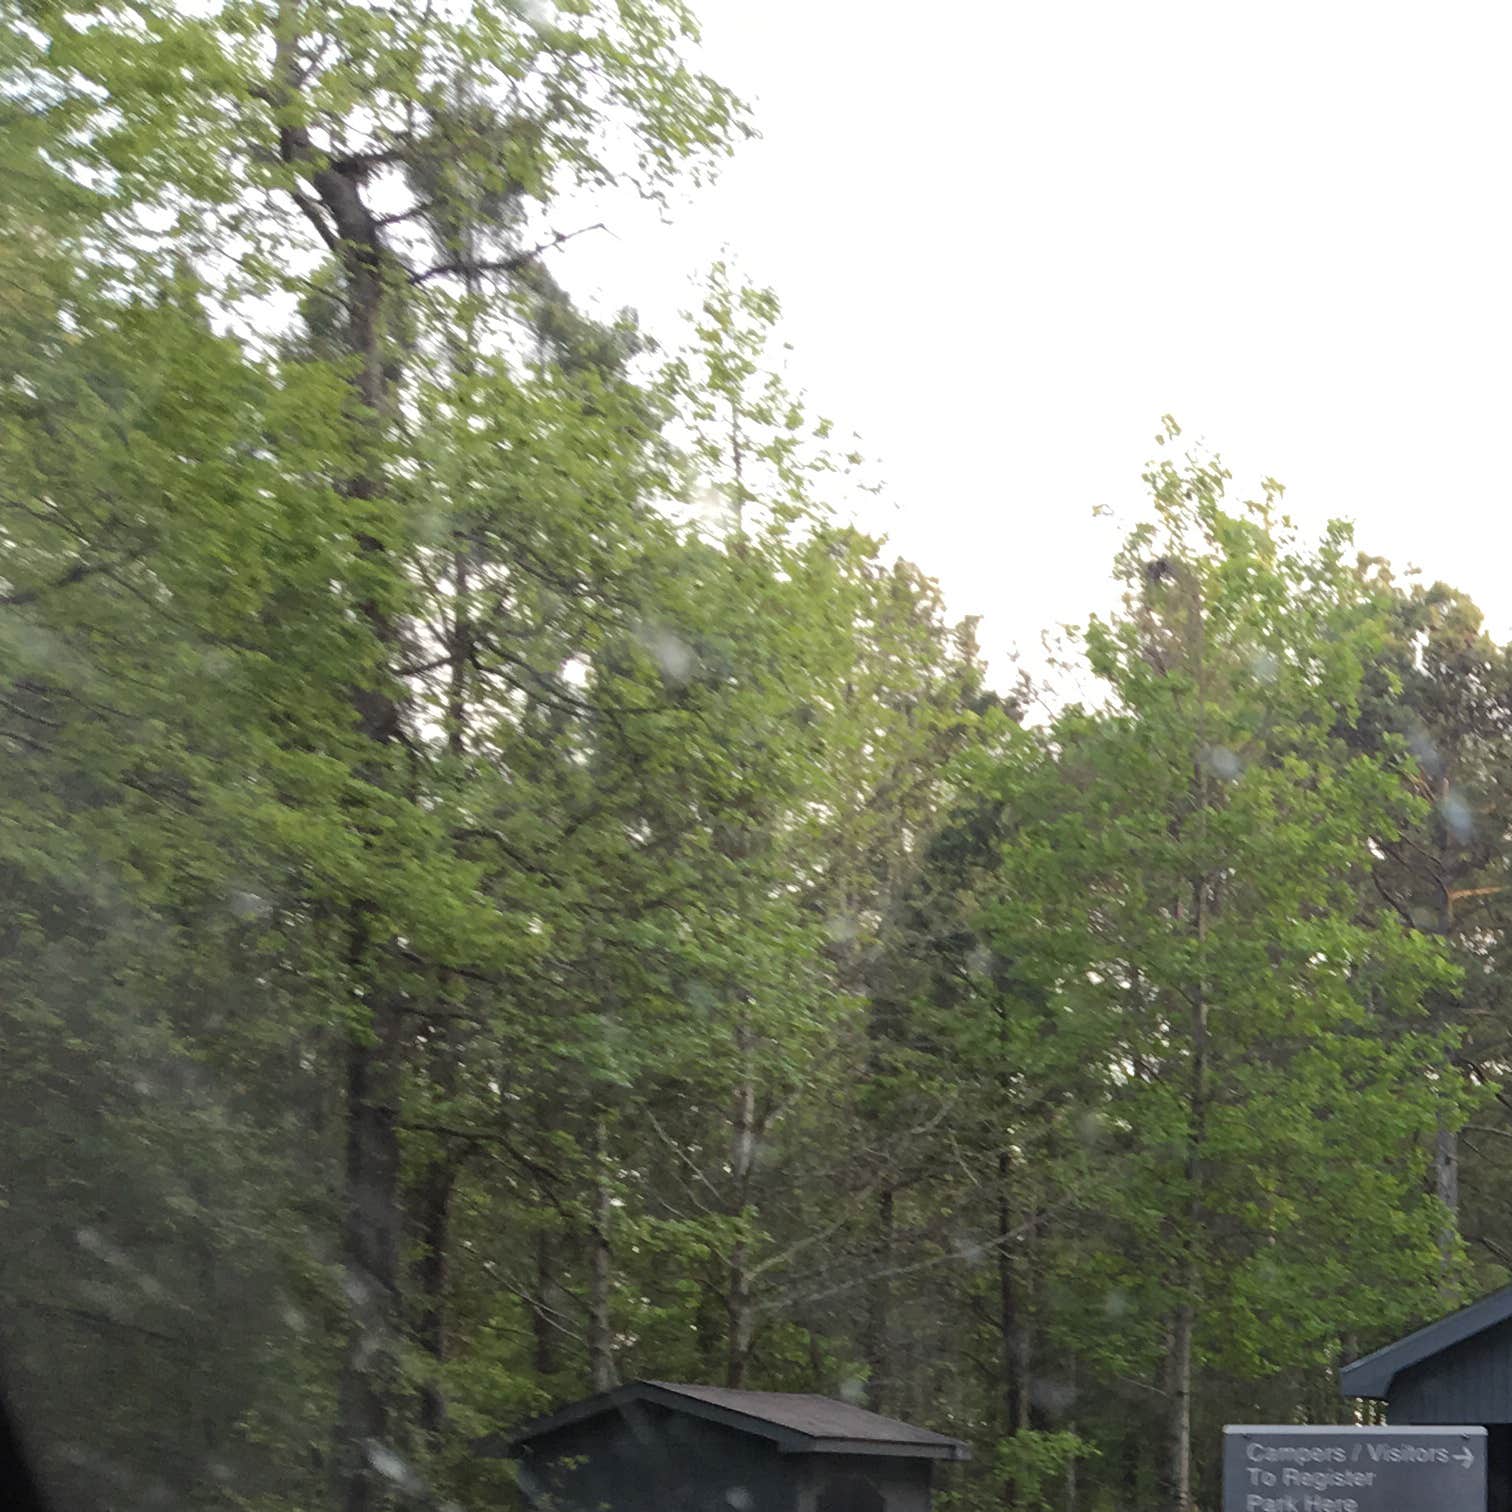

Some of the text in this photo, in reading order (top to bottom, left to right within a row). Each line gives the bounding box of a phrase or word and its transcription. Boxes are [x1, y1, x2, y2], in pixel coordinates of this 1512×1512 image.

[1246, 1442, 1347, 1466] Campers
[1366, 1442, 1450, 1464] Visitors
[1246, 1467, 1377, 1491] To Register
[1246, 1494, 1298, 1512] Park
